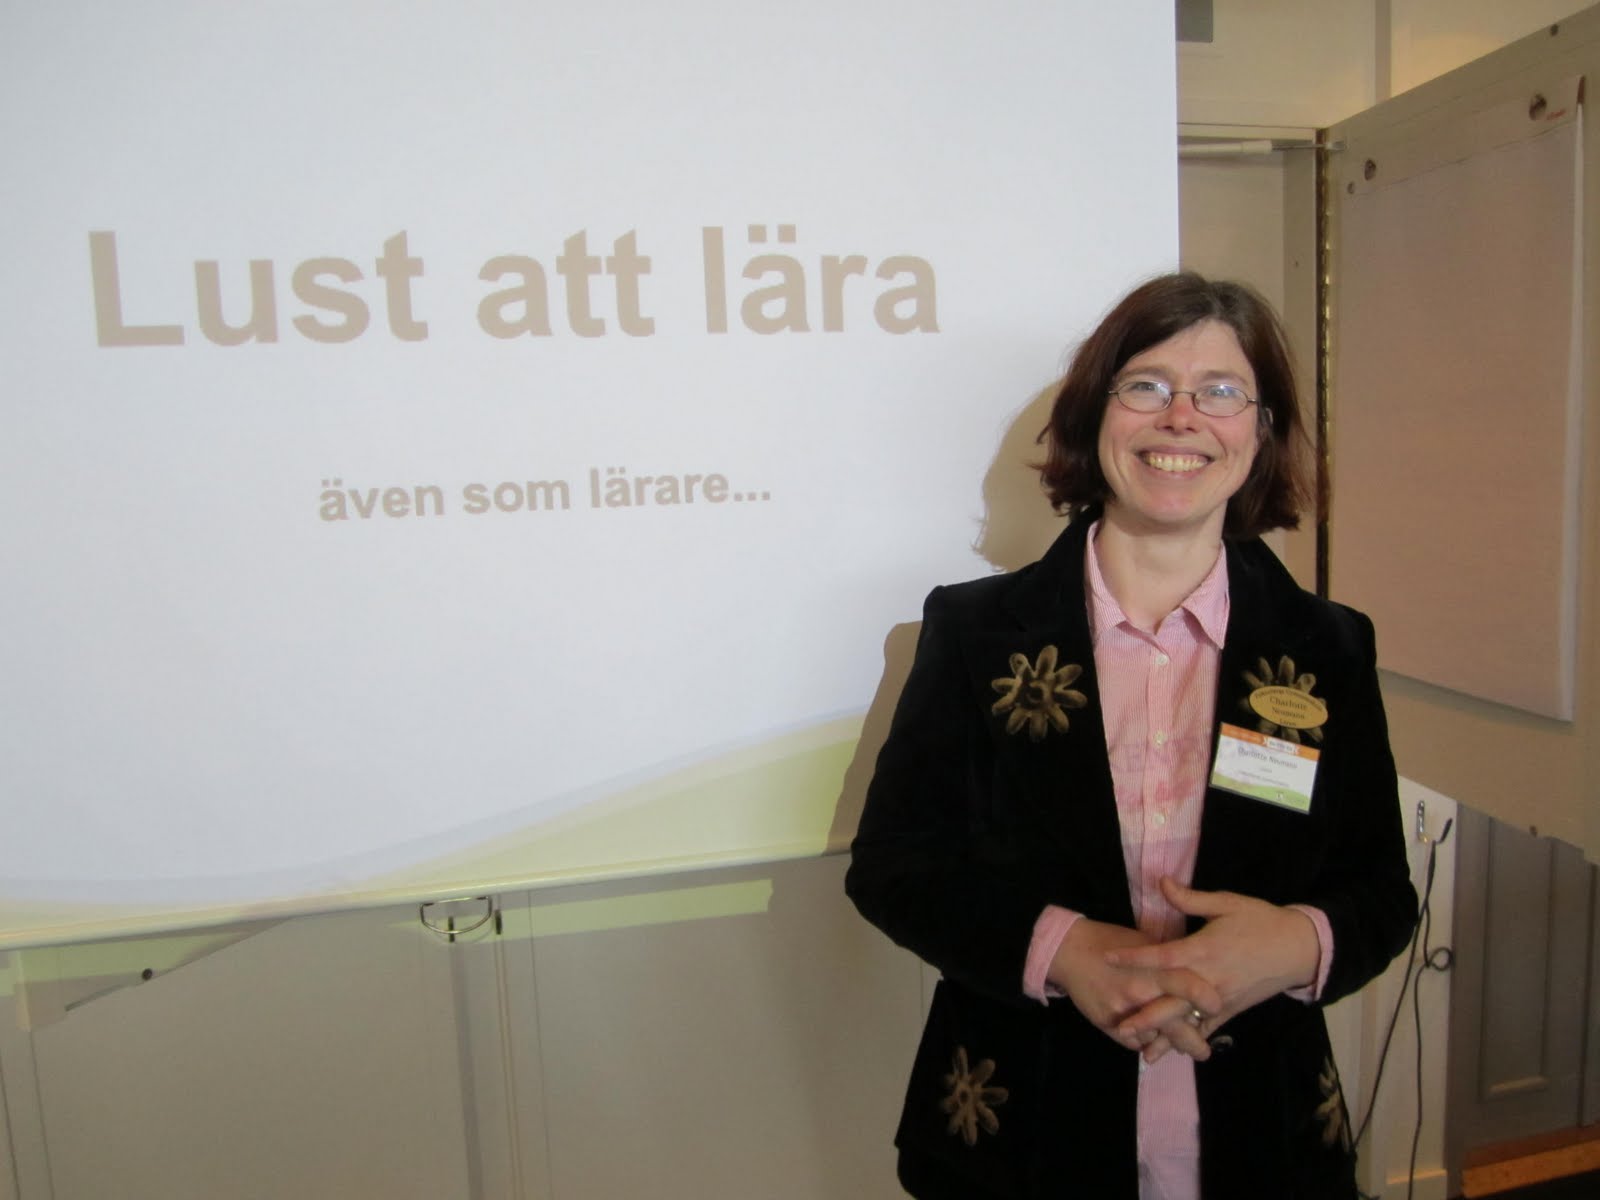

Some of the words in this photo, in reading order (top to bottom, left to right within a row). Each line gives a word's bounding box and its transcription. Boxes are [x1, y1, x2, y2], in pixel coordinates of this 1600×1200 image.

[88, 230, 428, 348] Lust
[477, 230, 655, 339] att
[702, 224, 941, 335] lära
[319, 478, 445, 523] även
[463, 479, 571, 515] som
[591, 467, 771, 509] lärare...
